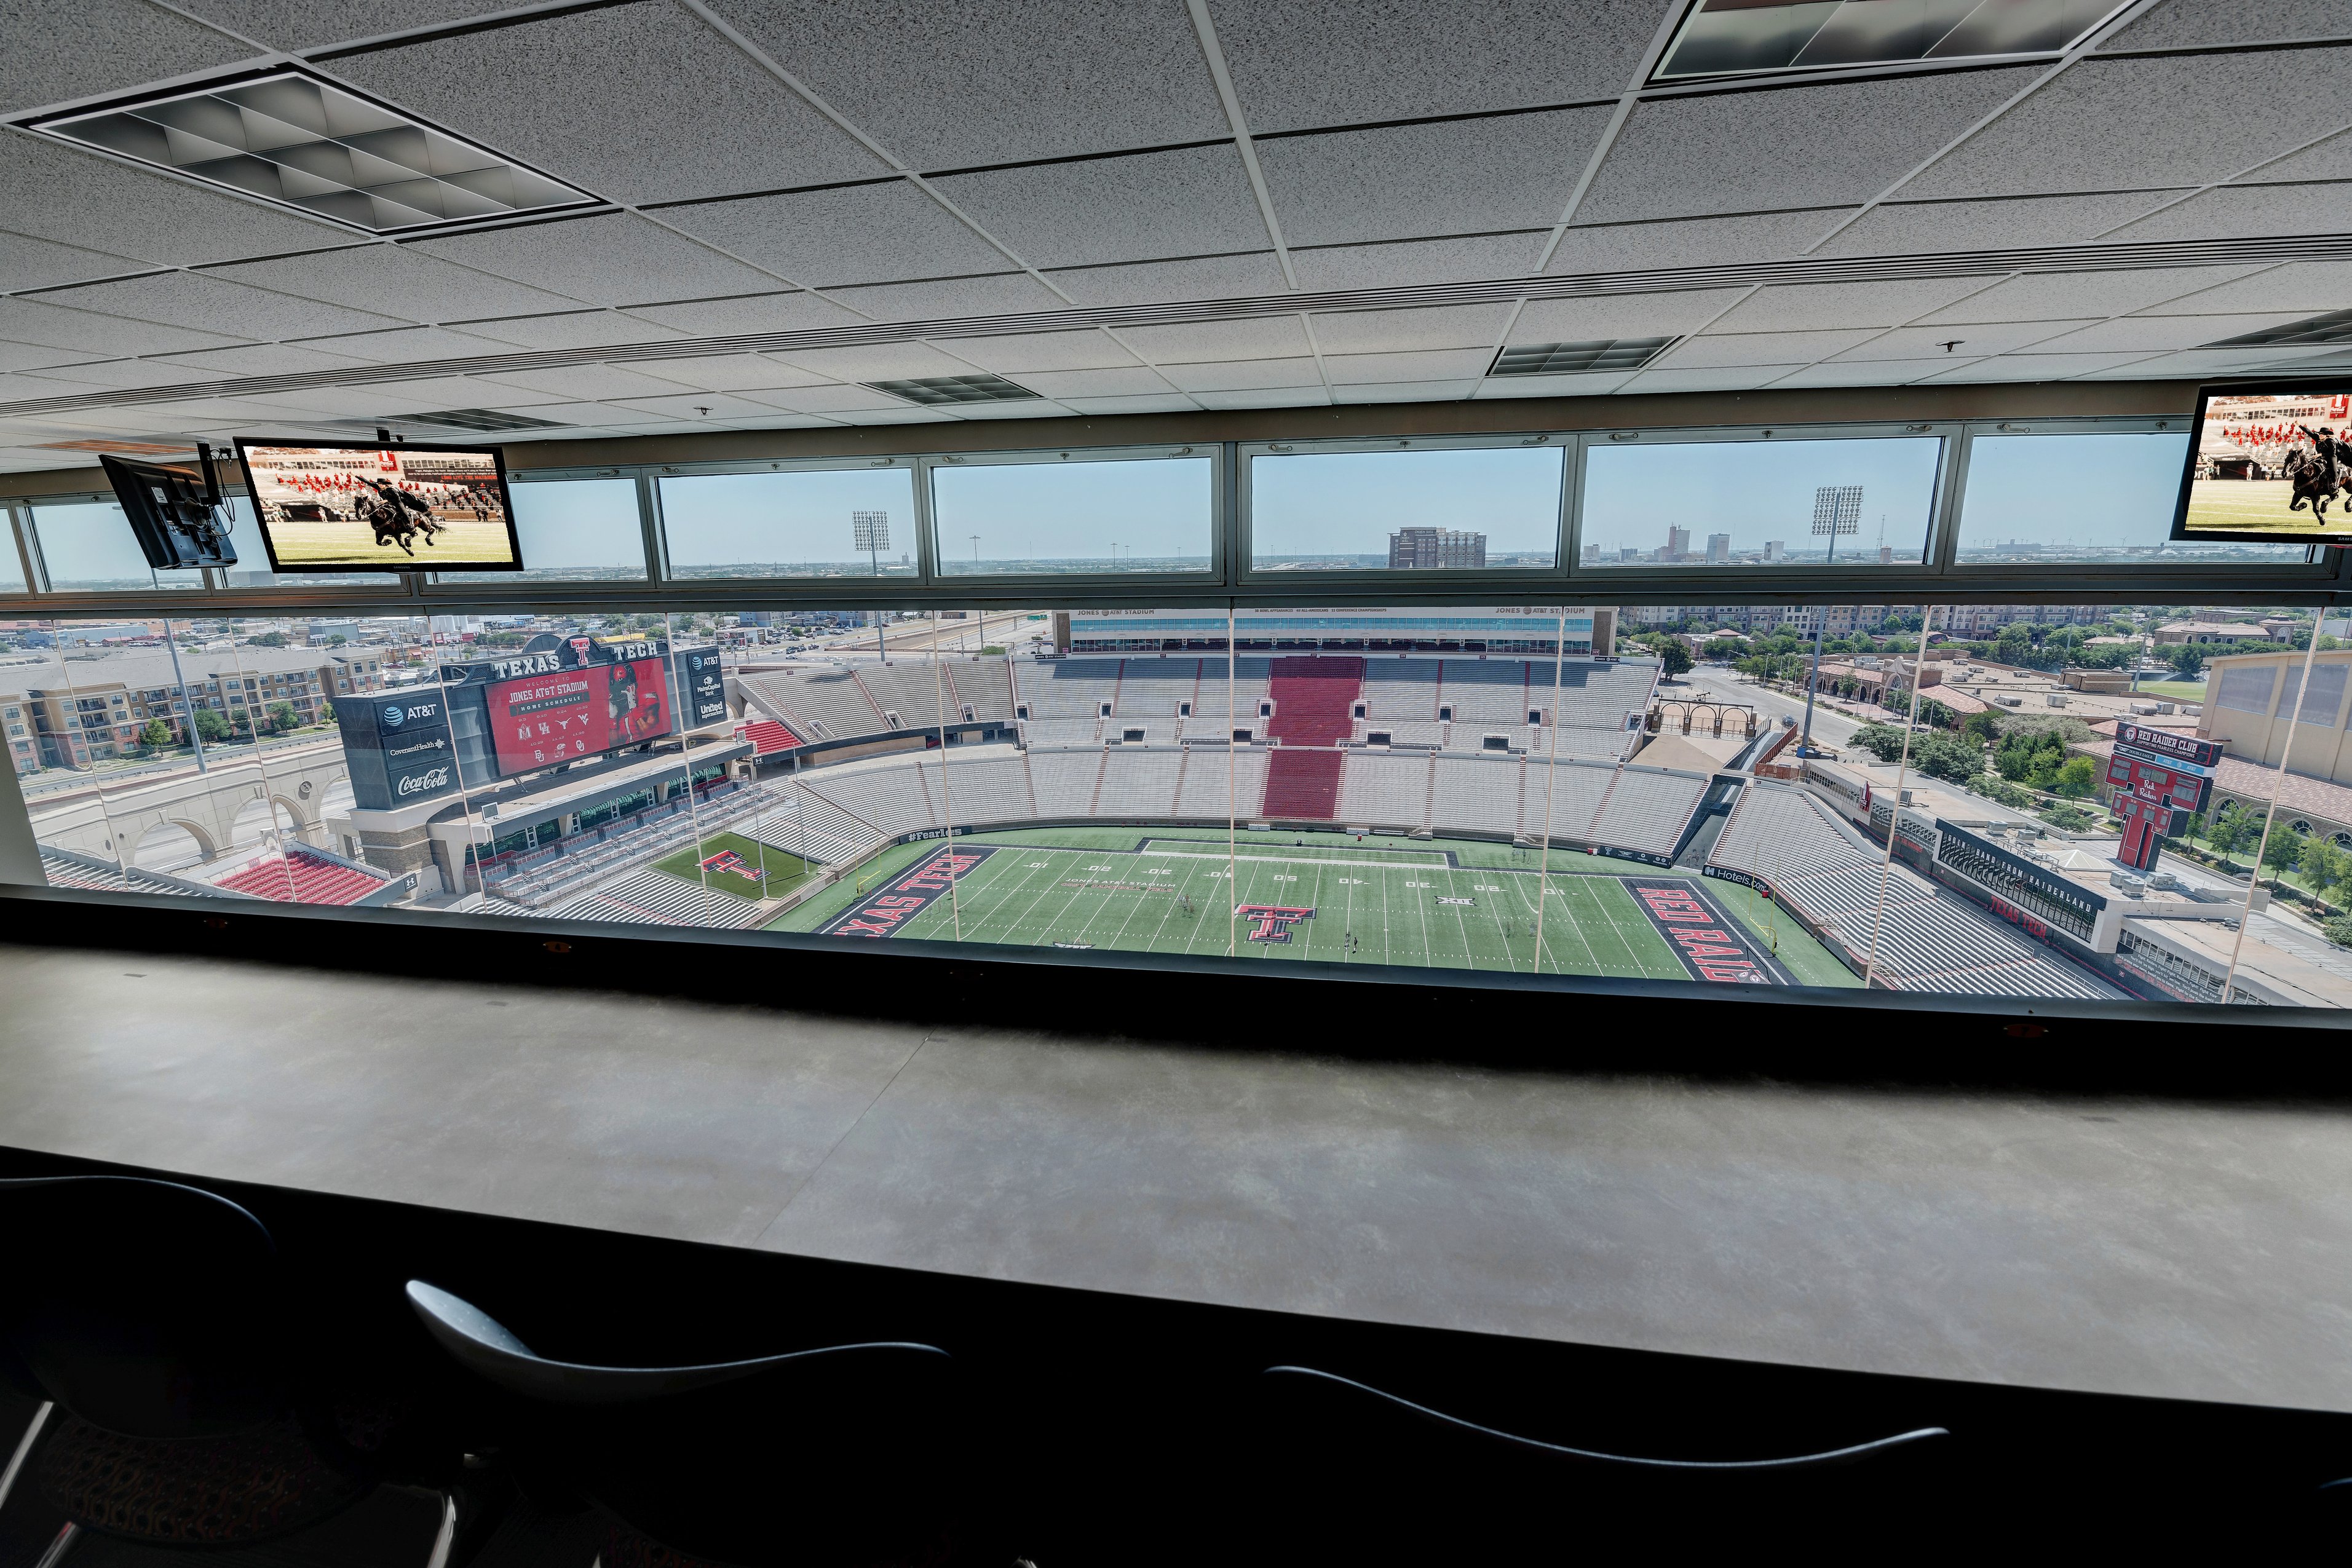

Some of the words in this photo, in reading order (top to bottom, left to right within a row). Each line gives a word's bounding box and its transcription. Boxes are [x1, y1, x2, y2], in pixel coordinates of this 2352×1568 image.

[494, 655, 560, 679] TEXAS
[613, 642, 659, 661] TECH
[703, 655, 719, 667] AT&T
[509, 689, 533, 703] JONES
[535, 685, 555, 699] AT&T
[557, 681, 588, 695] STADIUM
[526, 679, 558, 687] WELCOME
[697, 683, 721, 693] PlainsCapital
[407, 703, 437, 720] AT&T
[521, 703, 541, 711] HOME
[545, 695, 581, 707] SCHEDULE
[700, 701, 723, 715] United
[390, 742, 435, 756] CovenantHealth
[2136, 739, 2157, 749] SUPPORTING
[2174, 748, 2195, 758] CHAMPIONS
[2137, 730, 2152, 742] RED
[2152, 734, 2177, 748] RAIDER
[2178, 740, 2198, 753] CLUB
[398, 766, 449, 796] Coca-Cola
[2144, 779, 2156, 791] Red
[2139, 788, 2157, 801] Raiders
[1717, 869, 1766, 892] Hotels.com
[1976, 849, 1995, 861] BAND
[2002, 861, 2023, 878] FROM
[2029, 875, 2091, 913] RAIDERLAND
[833, 895, 926, 938] XAS
[895, 853, 982, 891] TECH
[1636, 887, 1714, 923] RED
[1991, 895, 2019, 925] TEXAS
[2022, 911, 2047, 939] TECH
